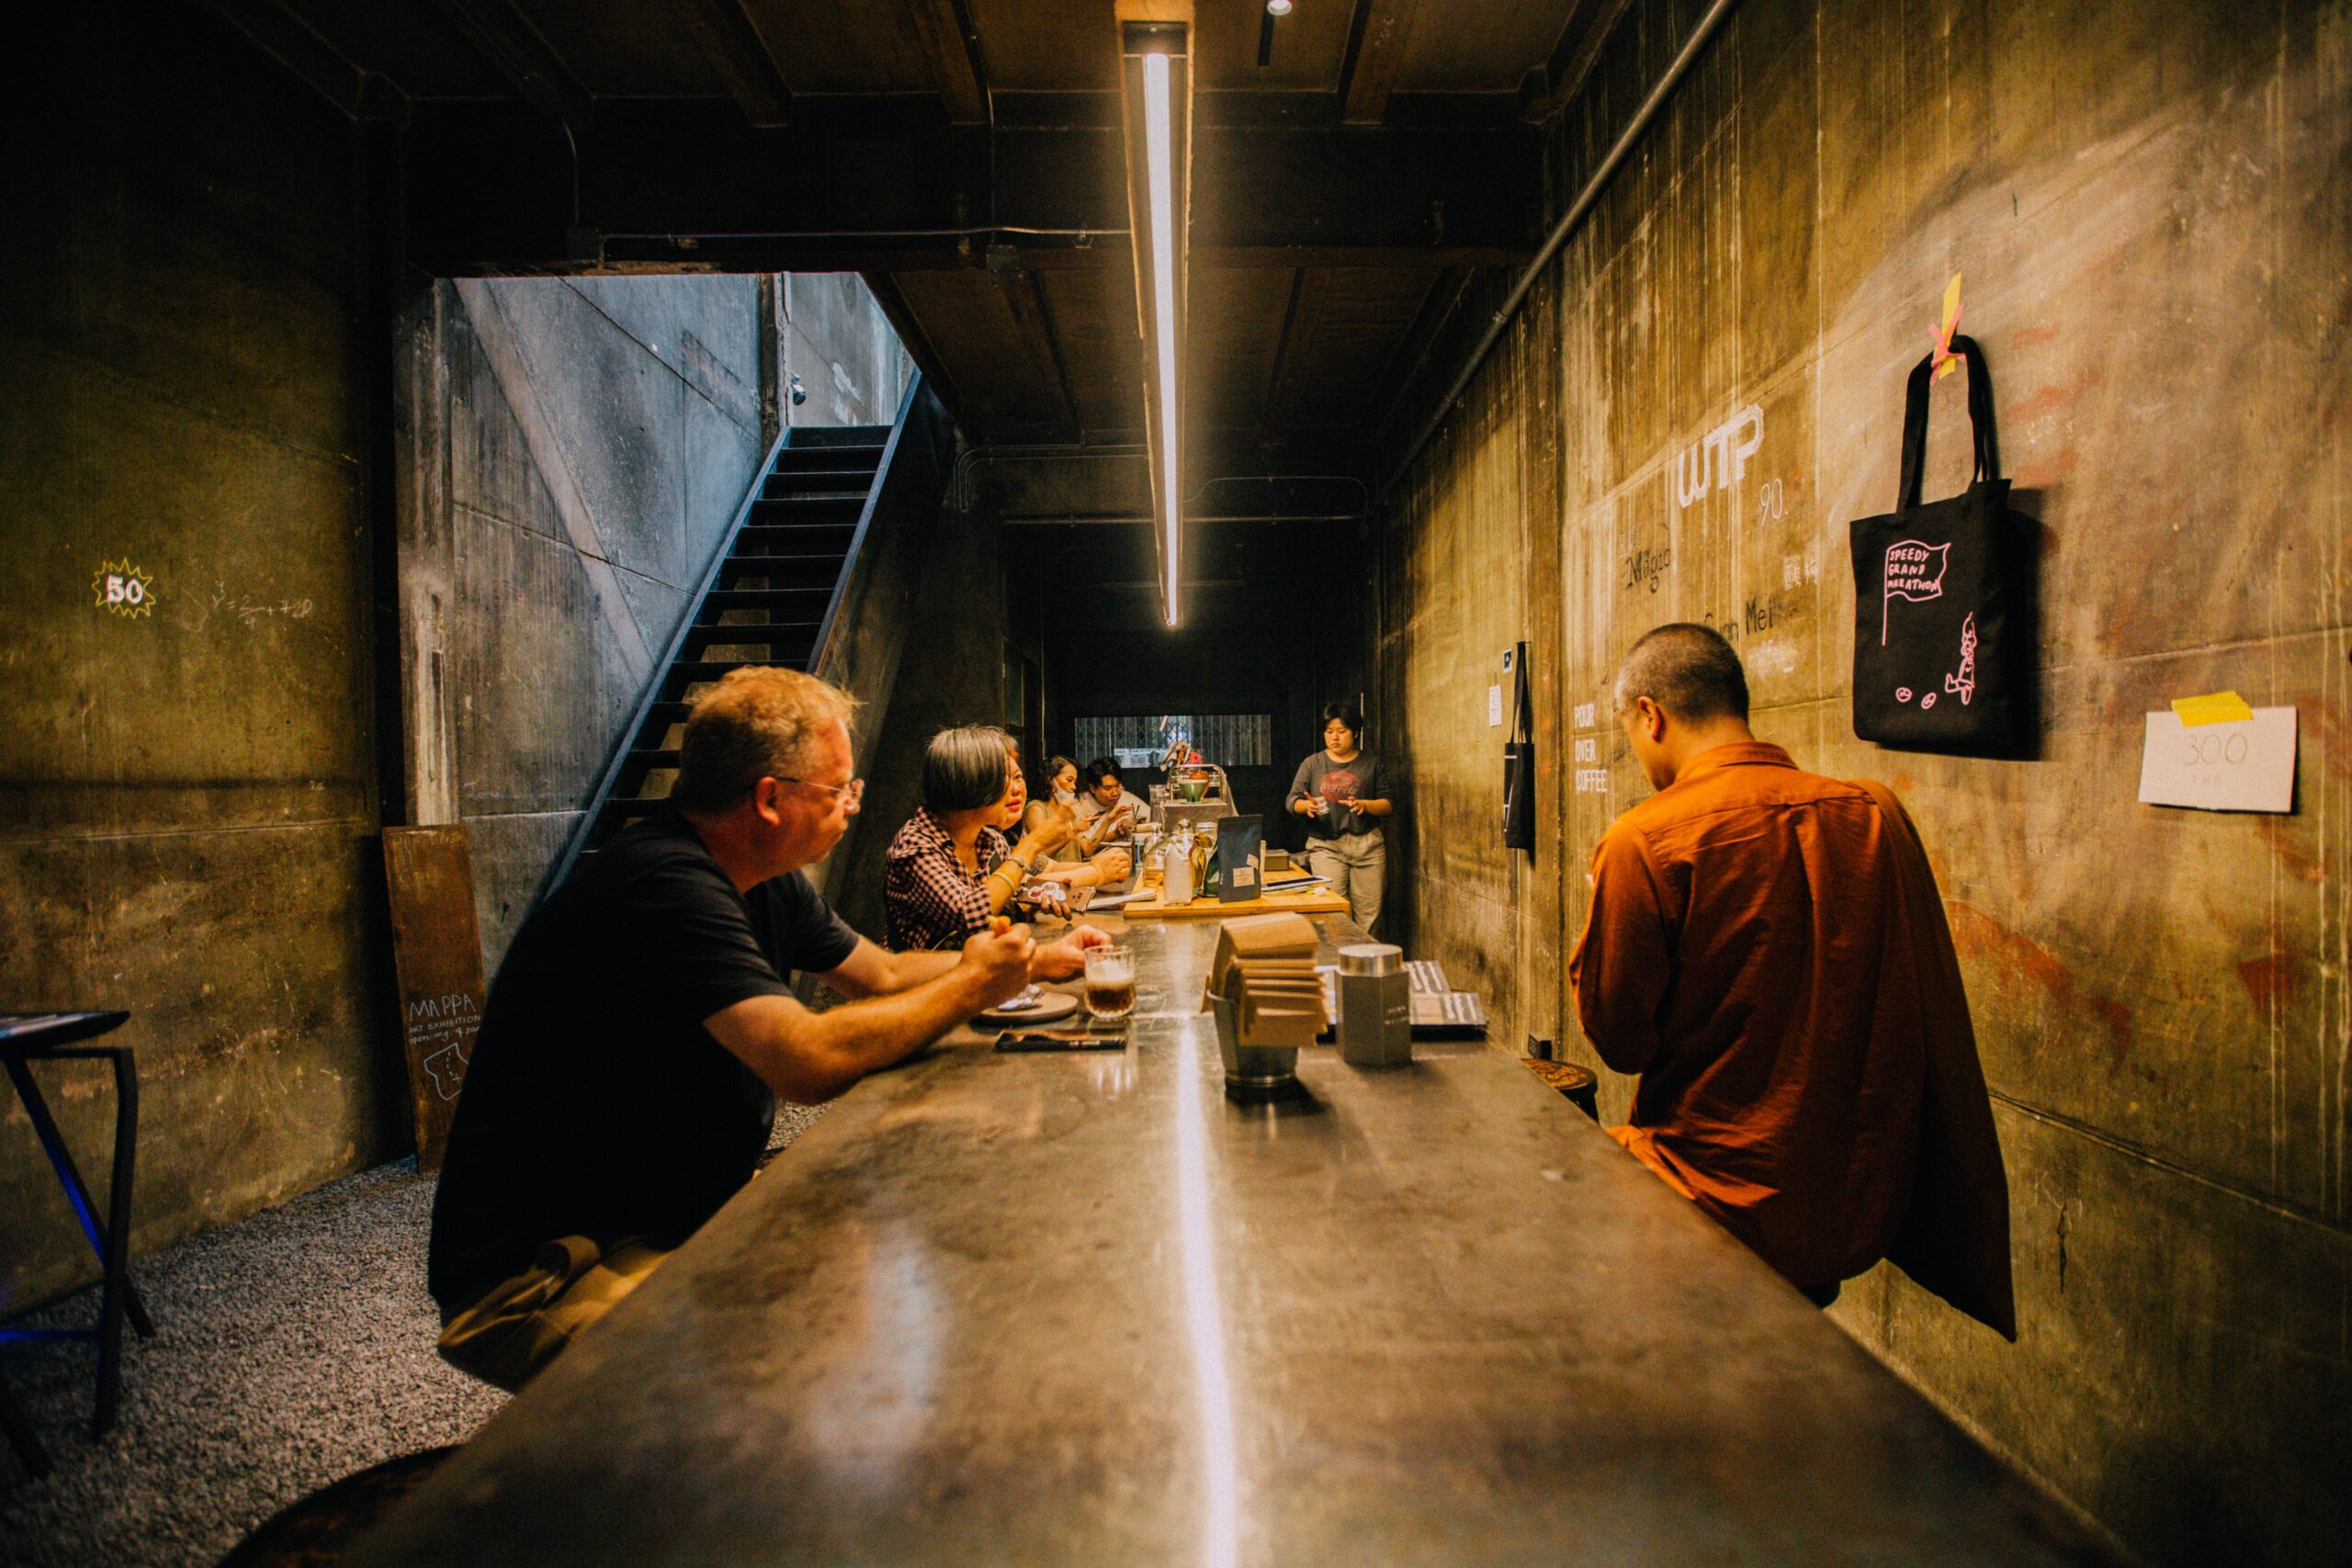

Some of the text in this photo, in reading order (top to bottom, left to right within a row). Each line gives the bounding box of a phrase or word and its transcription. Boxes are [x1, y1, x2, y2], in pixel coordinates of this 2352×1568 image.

[1678, 403, 1764, 508] WTP
[1760, 478, 1782, 527] 90
[1889, 547, 1929, 562] SPEEDY
[1888, 563, 1926, 576] GRAND
[107, 574, 143, 604] 50
[1887, 578, 1938, 592] MARATHON
[1574, 702, 1595, 728] POUR
[1575, 739, 1596, 763] OVER
[2183, 733, 2247, 765] 300
[1576, 768, 1607, 795] COFFEE
[410, 993, 477, 1021] MAPPA
[427, 1014, 481, 1030] EXHIBITION
